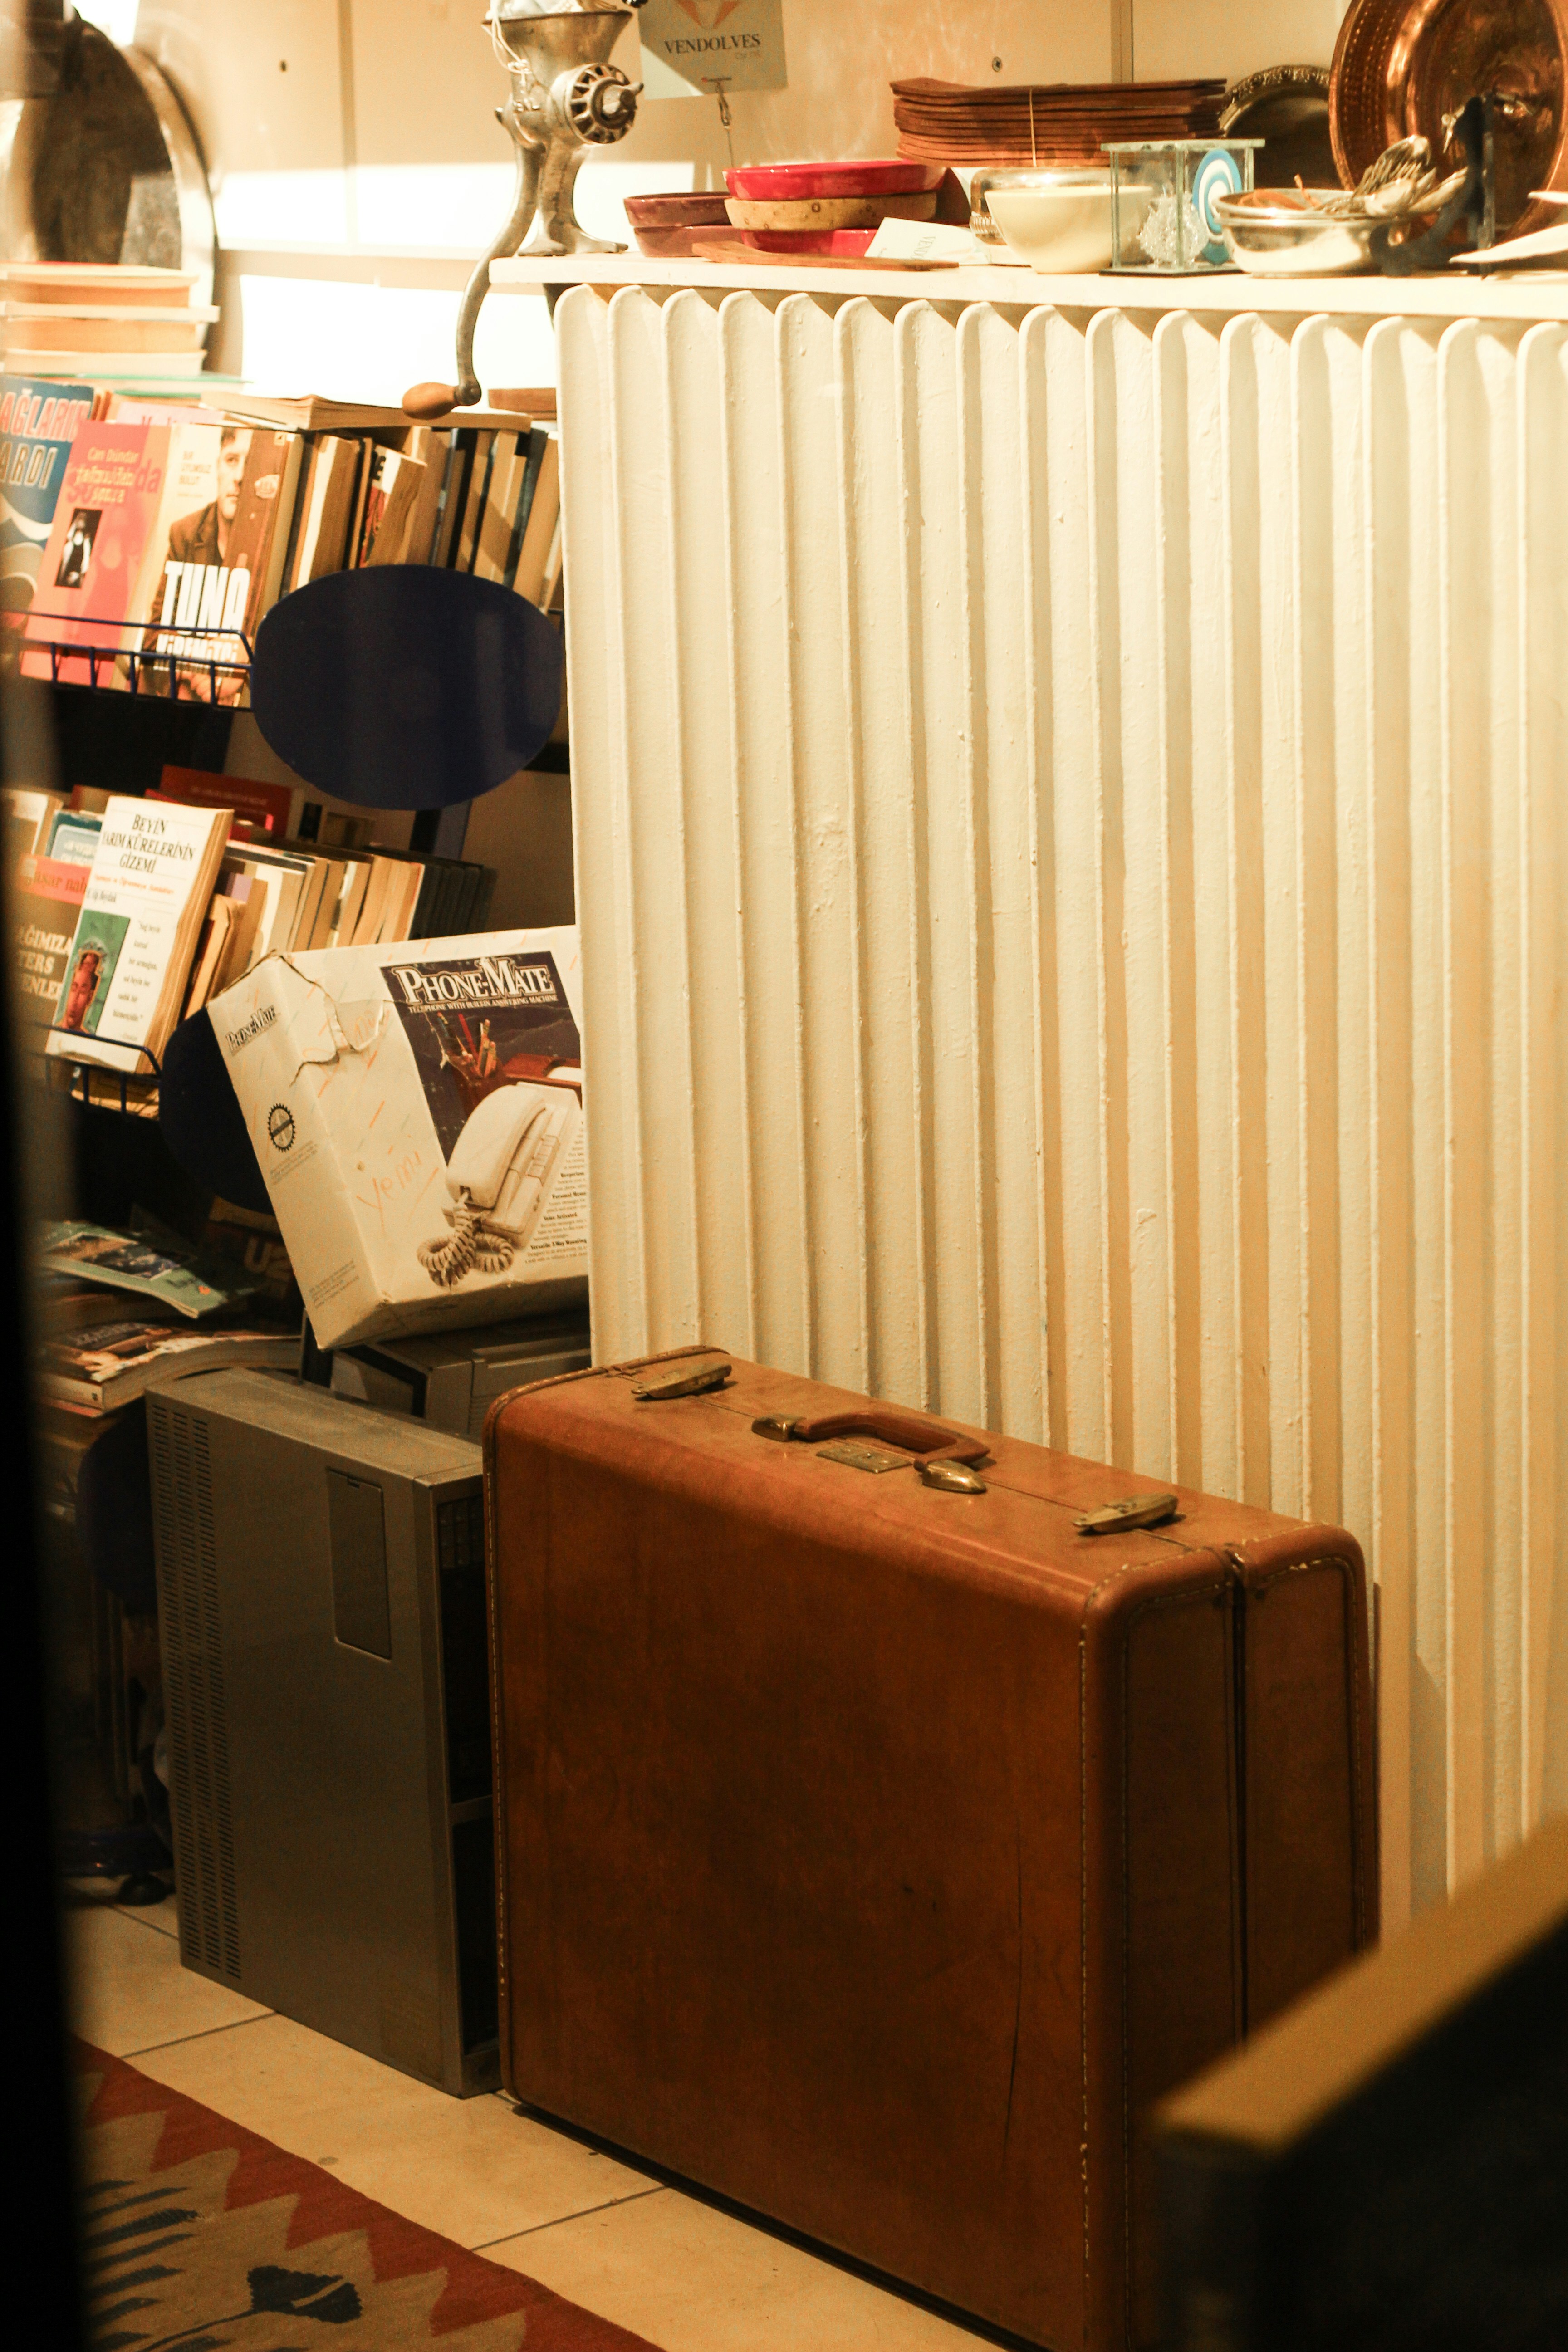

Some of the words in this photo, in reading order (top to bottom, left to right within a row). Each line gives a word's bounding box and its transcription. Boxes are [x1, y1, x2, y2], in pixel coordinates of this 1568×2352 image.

[664, 33, 761, 54] VENDOLVES
[160, 560, 250, 640] TUNA
[132, 813, 169, 835] BEYİN
[119, 851, 157, 874] GİZEMİ
[394, 957, 553, 1004] PHONE-MATE
[408, 1004, 446, 1014] TELEPHONE
[447, 1001, 466, 1010] WITH
[492, 997, 529, 1007] ANSWERING
[529, 994, 559, 1004] MACHINE
